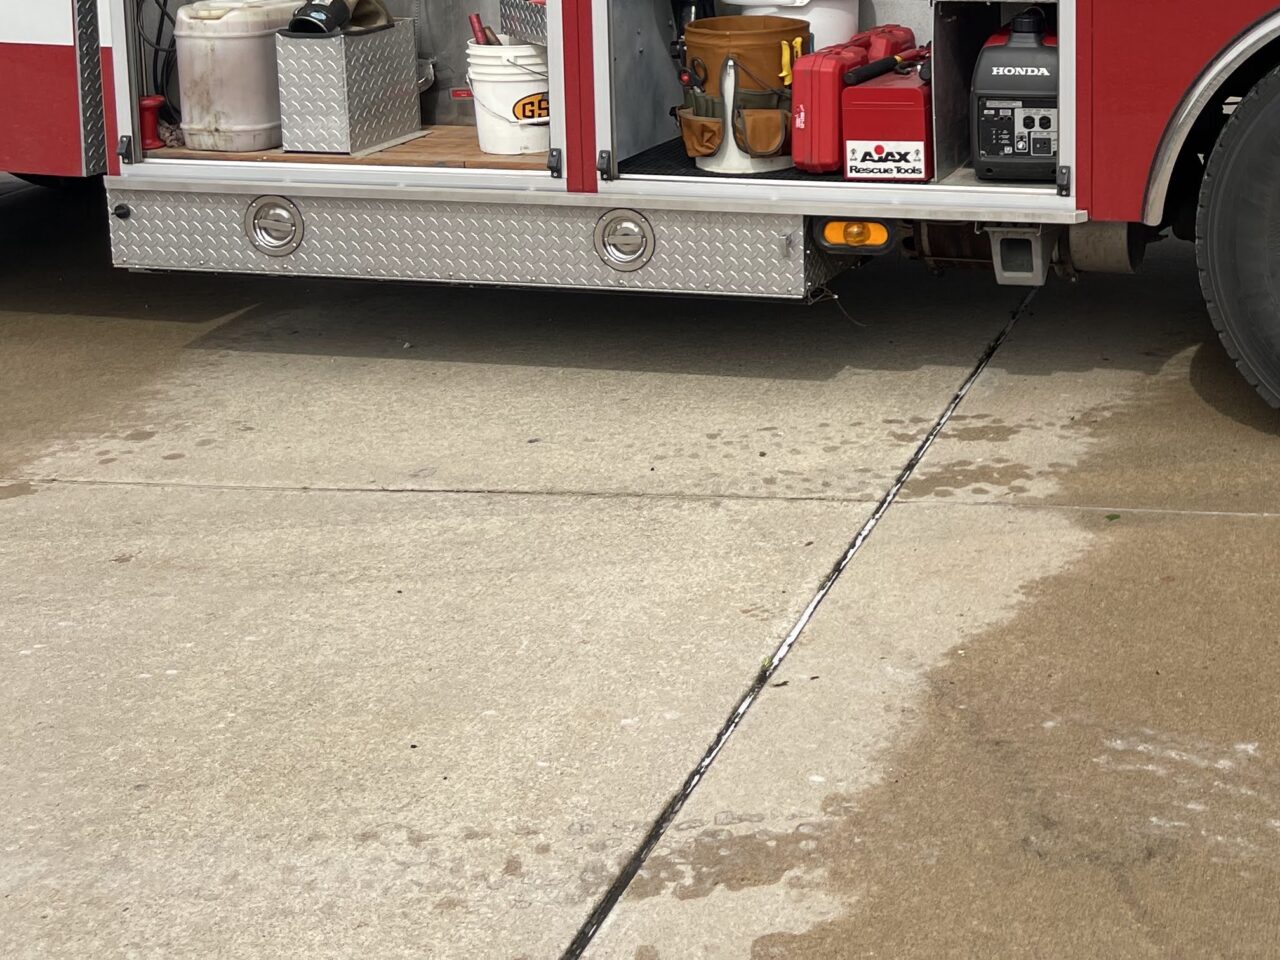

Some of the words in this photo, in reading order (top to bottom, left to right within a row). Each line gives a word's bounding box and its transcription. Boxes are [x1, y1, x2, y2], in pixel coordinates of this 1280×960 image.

[991, 66, 1051, 76] HONDA
[849, 165, 893, 175] Rescue
[894, 166, 923, 175] Tools
